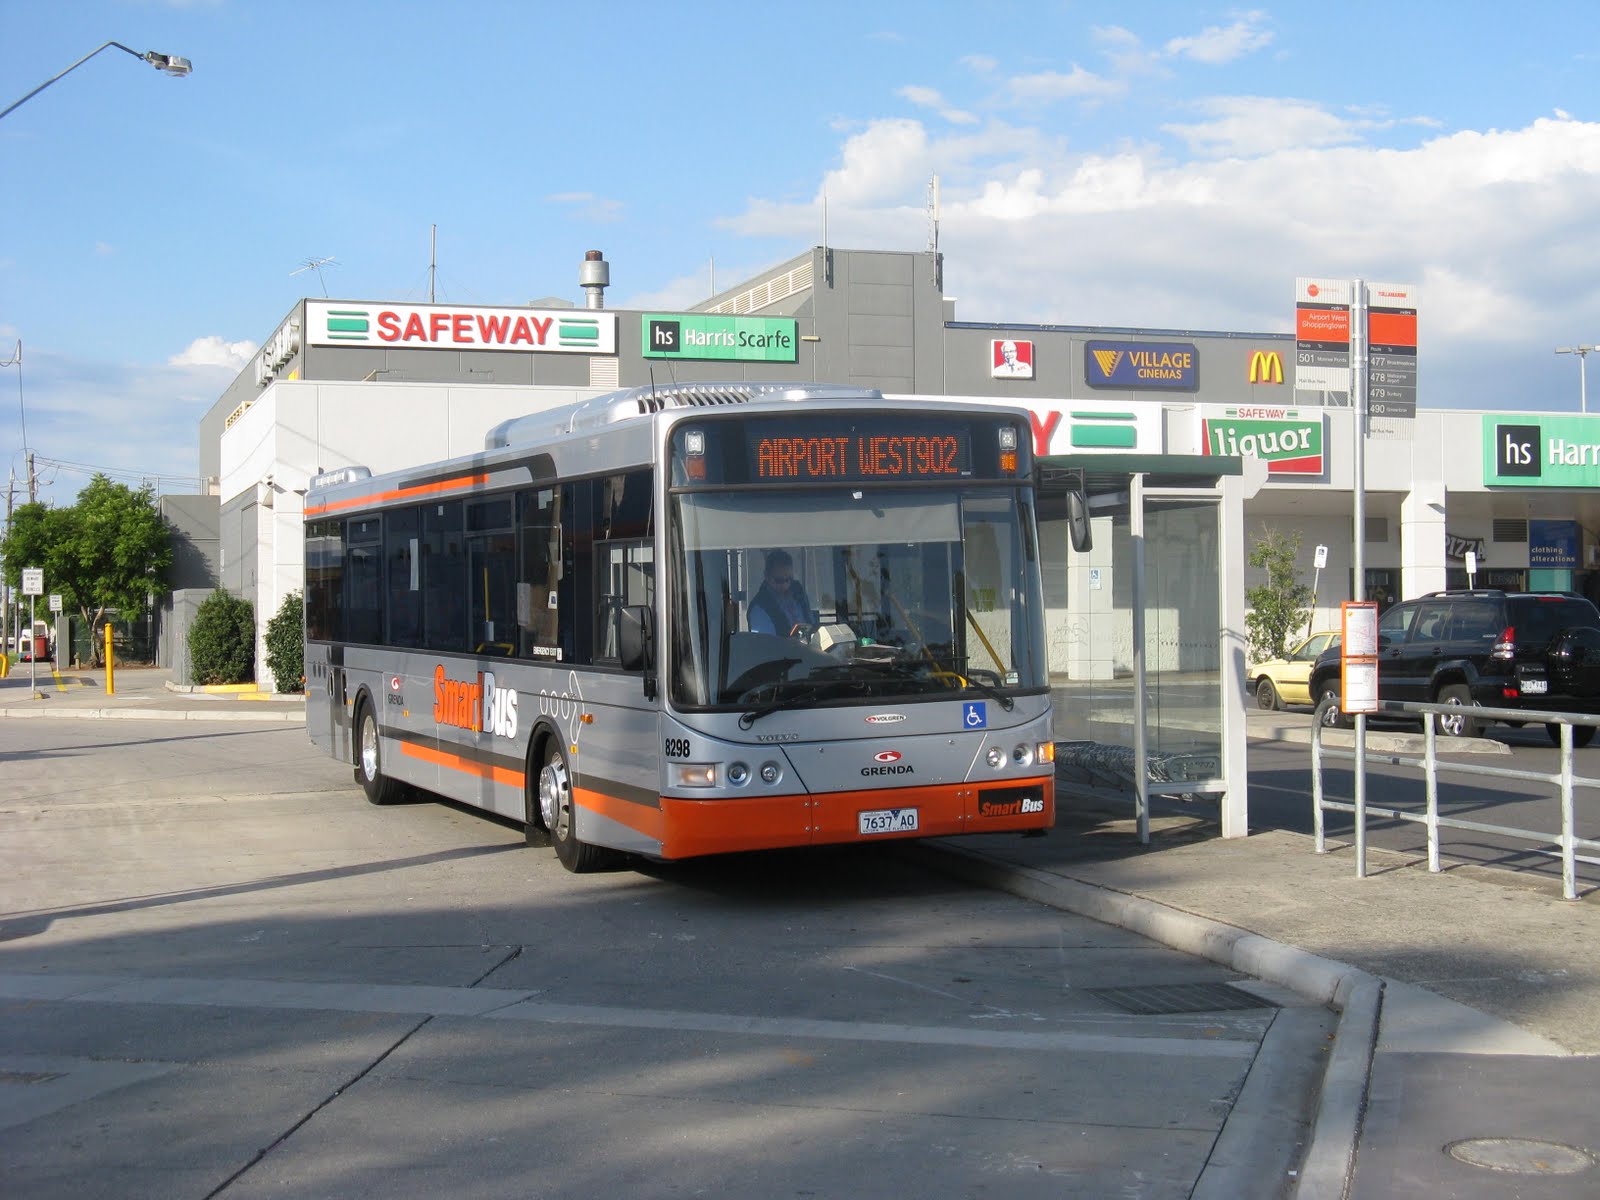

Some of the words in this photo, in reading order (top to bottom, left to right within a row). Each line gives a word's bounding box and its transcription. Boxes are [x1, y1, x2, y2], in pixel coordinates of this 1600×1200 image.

[1309, 313, 1330, 321] Airport
[1331, 314, 1347, 322] West
[377, 311, 553, 345] SAFEWAY
[1302, 320, 1347, 330] Shoppingtown
[655, 326, 674, 345] hs
[685, 329, 735, 346] Harris
[739, 330, 790, 348] Scarfe
[1128, 351, 1191, 368] VILLAGE
[1299, 353, 1314, 363] 501
[1370, 357, 1385, 366] 477
[1138, 368, 1182, 379] CINEMAS
[1370, 373, 1385, 382] 478
[1370, 388, 1385, 397] 479
[1239, 408, 1285, 418] SAFEWAY
[1370, 404, 1385, 413] 490
[1215, 428, 1311, 460] liquor
[1506, 434, 1531, 464] hs
[758, 438, 848, 476] AIRPORT
[388, 694, 404, 706] GRENDA
[757, 734, 799, 742] VOLVO
[665, 738, 690, 758] 8298
[861, 765, 914, 776] GRENDA
[864, 816, 892, 829] 7637
